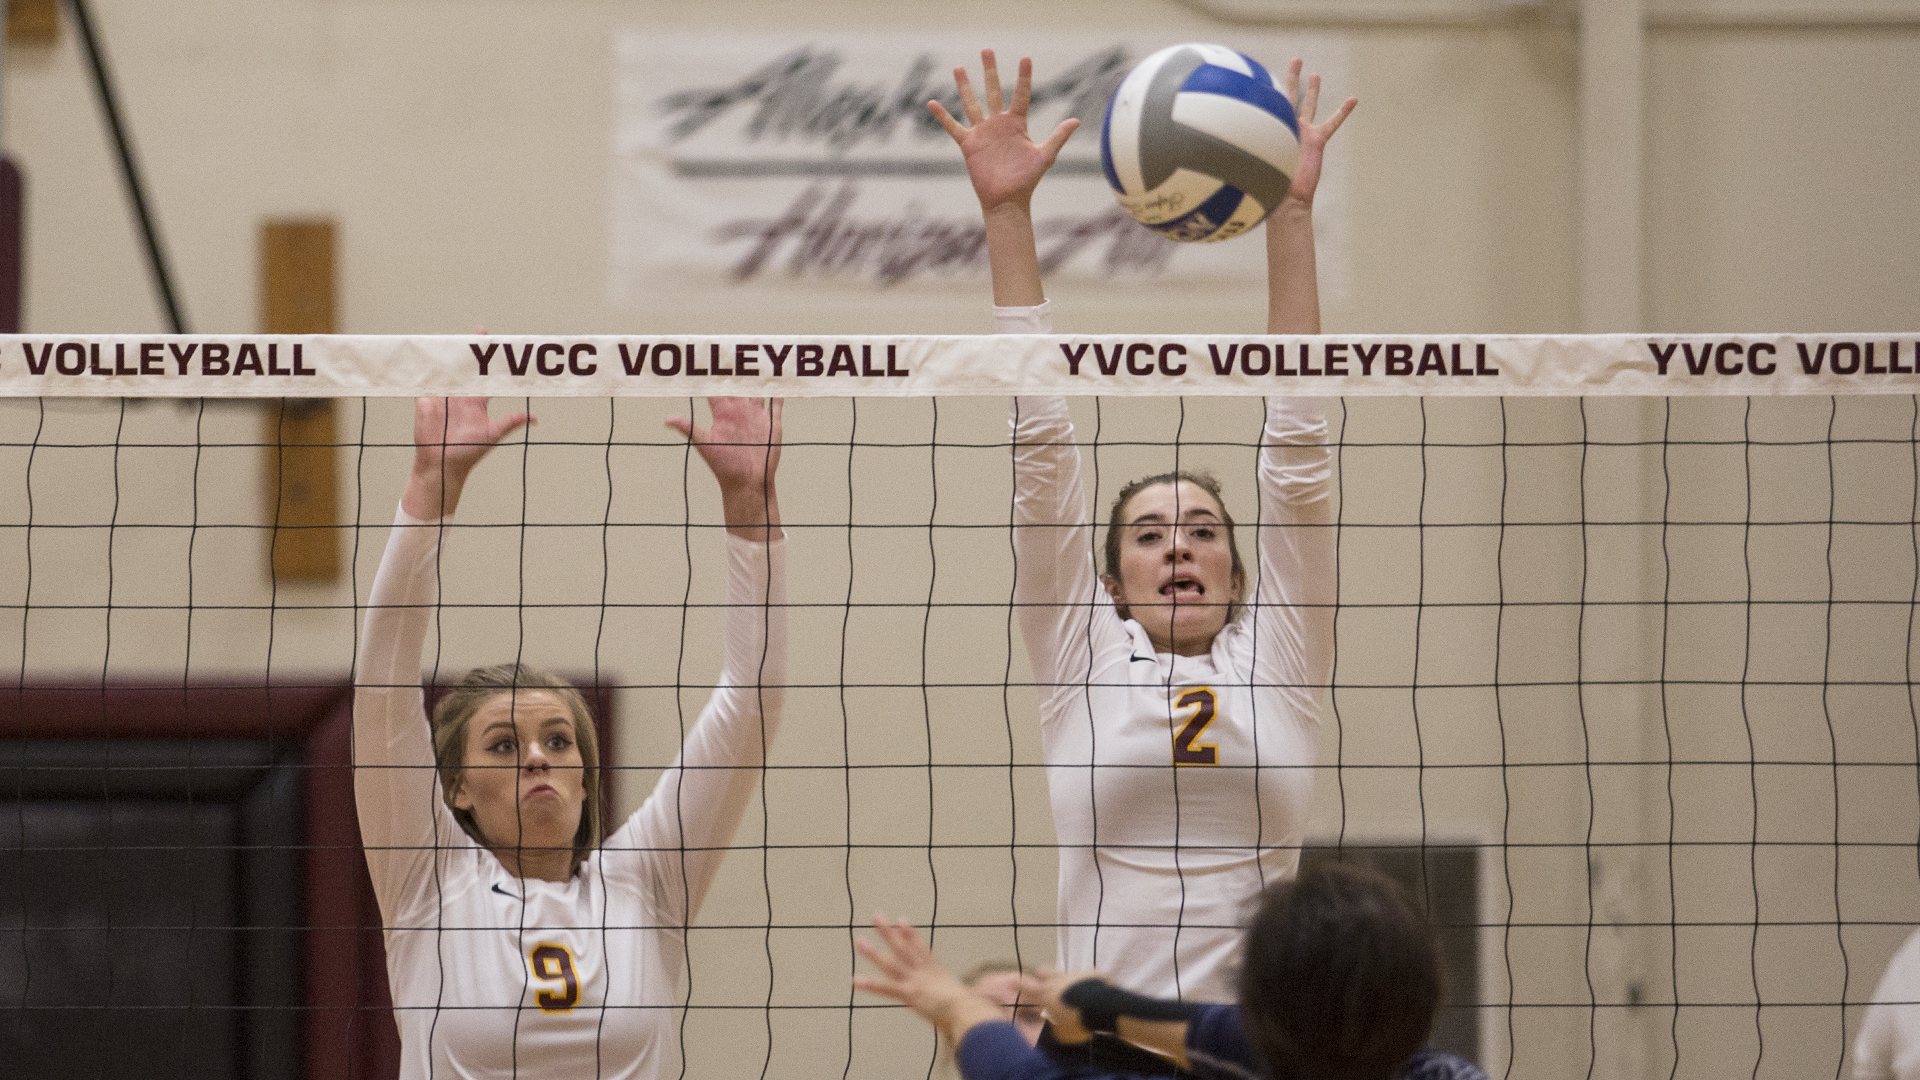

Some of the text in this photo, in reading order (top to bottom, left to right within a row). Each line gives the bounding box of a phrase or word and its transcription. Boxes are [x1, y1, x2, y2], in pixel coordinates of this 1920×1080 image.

[22, 342, 316, 376] VOLLEYBALL
[469, 343, 910, 377] YVCC VOLLEYBALL
[1059, 343, 1499, 377] YVCC VOLLEYBALL
[1647, 341, 1920, 376] YVCC VOLL
[1172, 686, 1219, 767] 2
[529, 941, 582, 1014] 9
